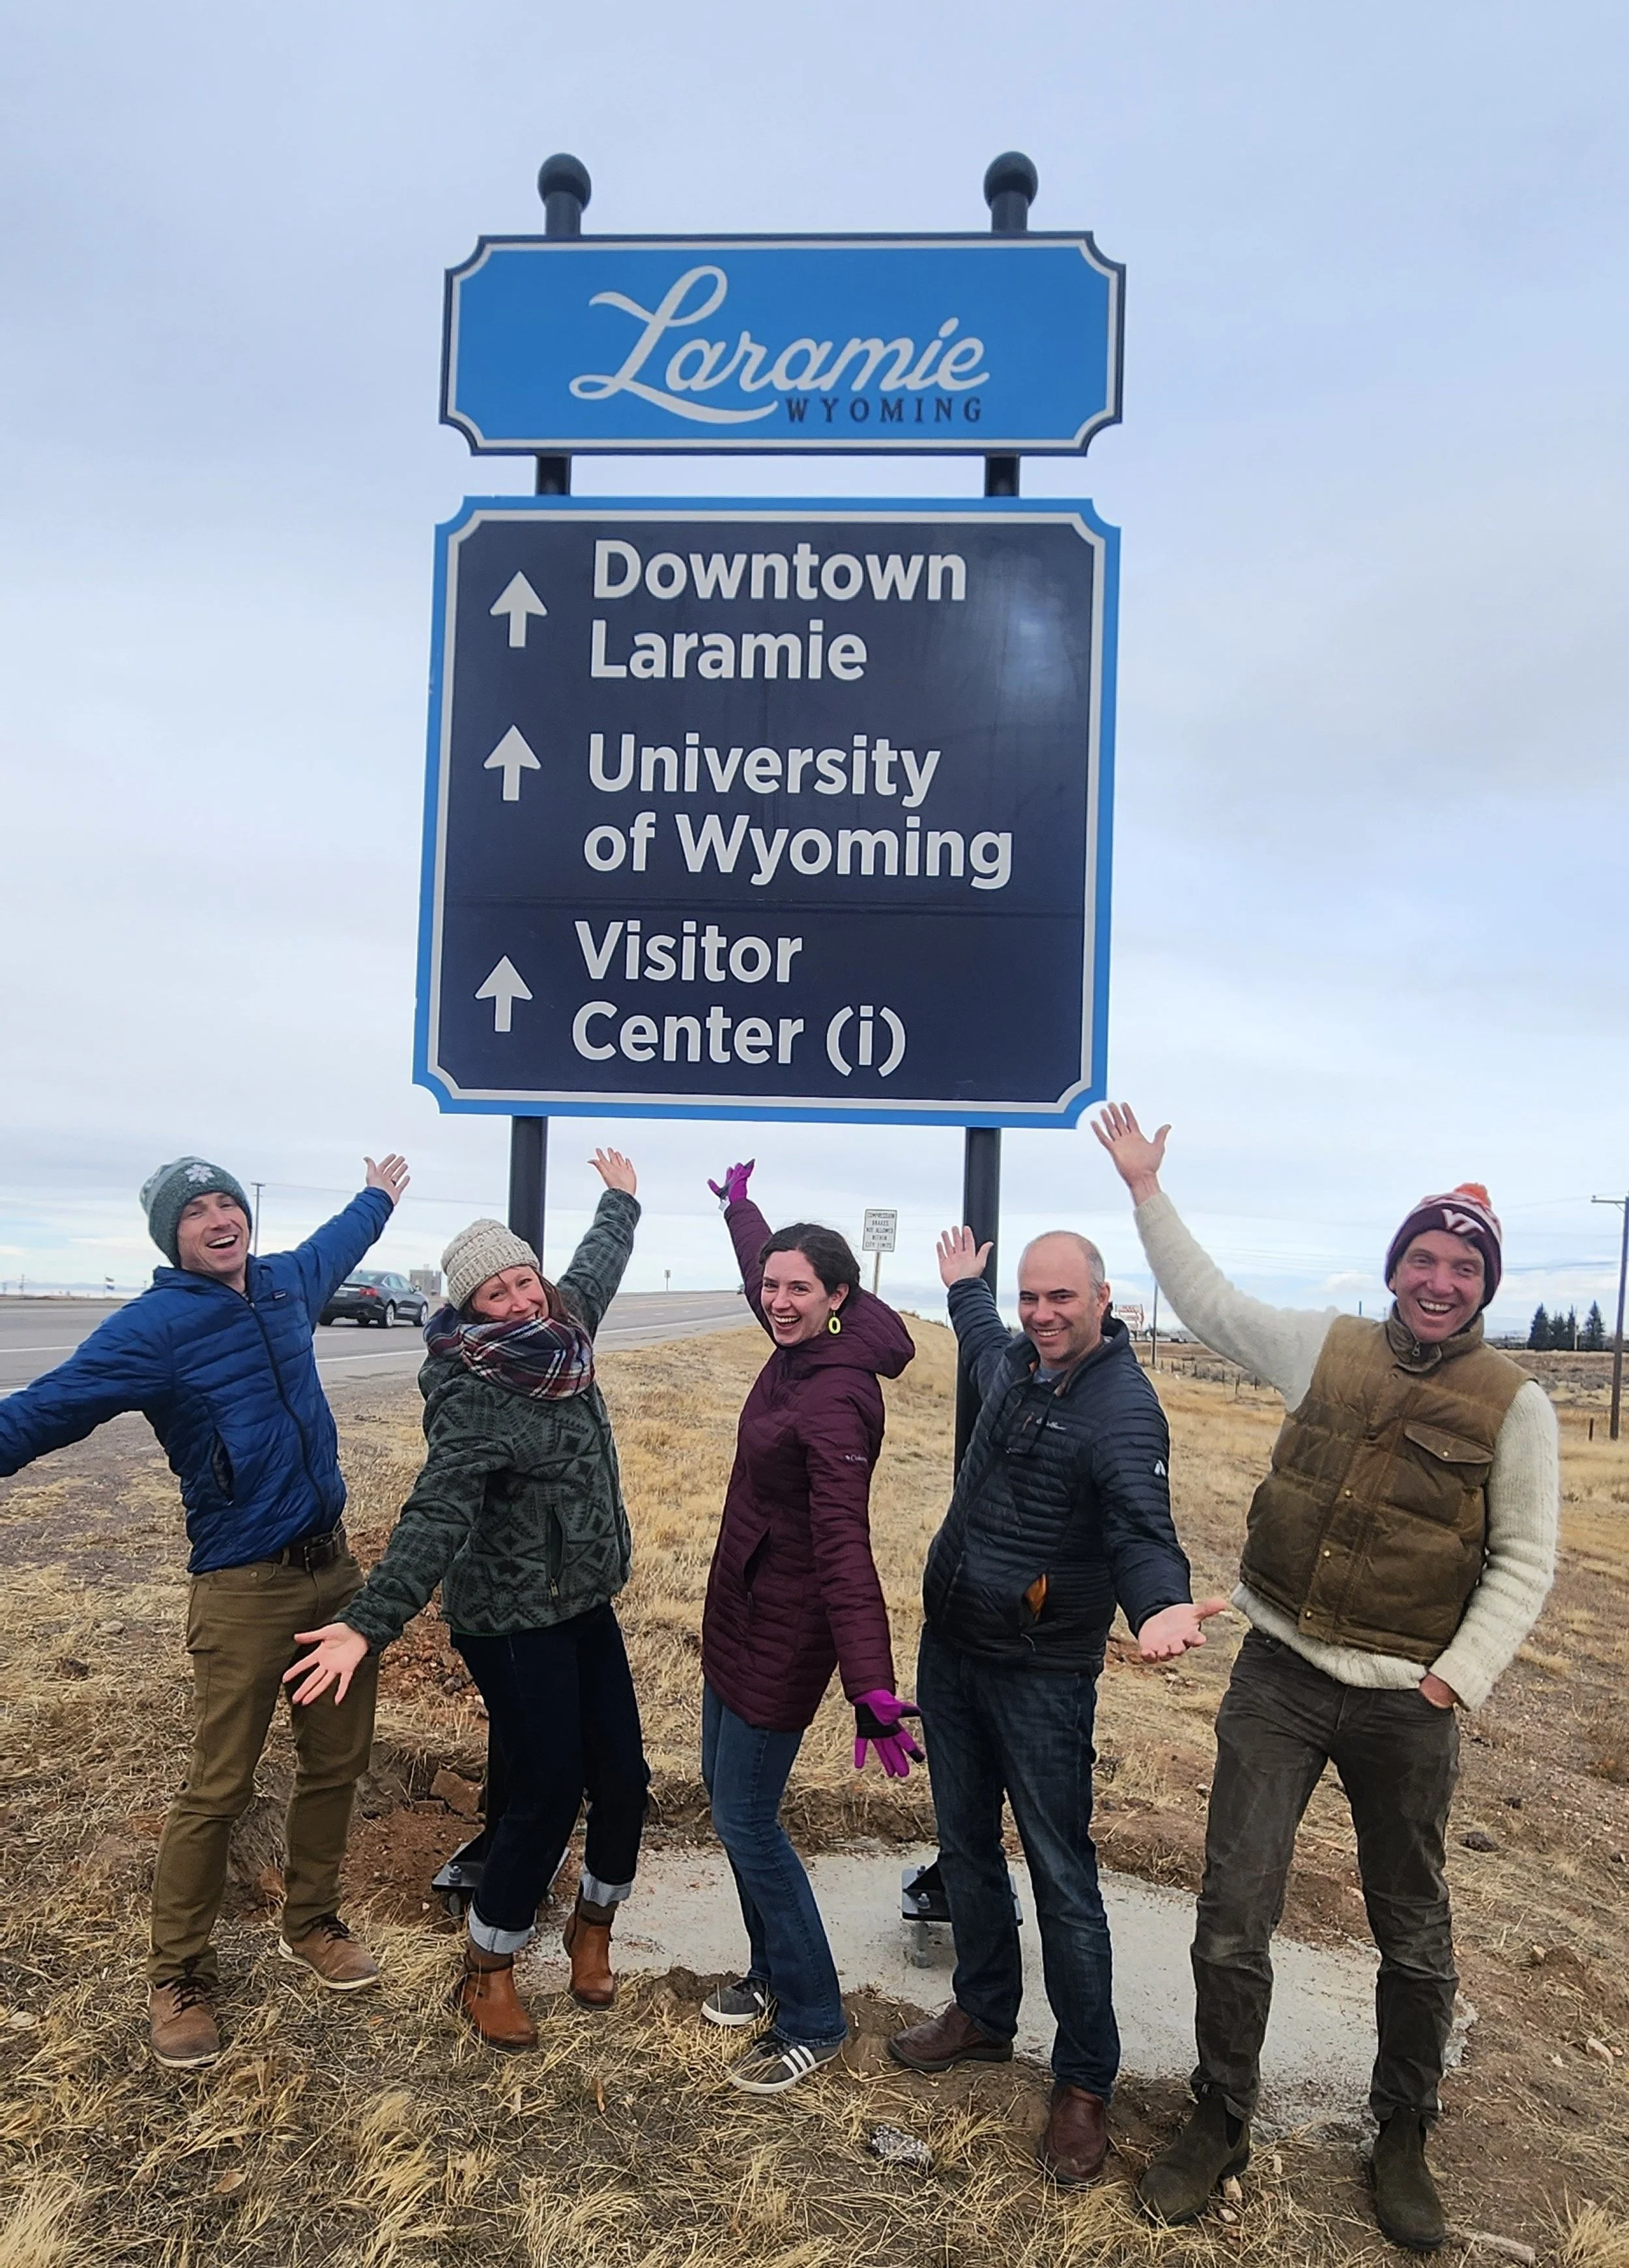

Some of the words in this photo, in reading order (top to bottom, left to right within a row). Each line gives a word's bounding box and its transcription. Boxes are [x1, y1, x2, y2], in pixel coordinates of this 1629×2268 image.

[570, 266, 988, 424] Laramie
[785, 396, 982, 424] WYOMING
[594, 540, 966, 600] Downtown
[591, 619, 867, 680] Laramie
[589, 733, 941, 807] University
[584, 811, 656, 871] of
[675, 814, 1012, 890] Wyoming
[575, 920, 802, 983] Visitor
[573, 1001, 804, 1064] Center
[826, 1005, 906, 1077] (i)
